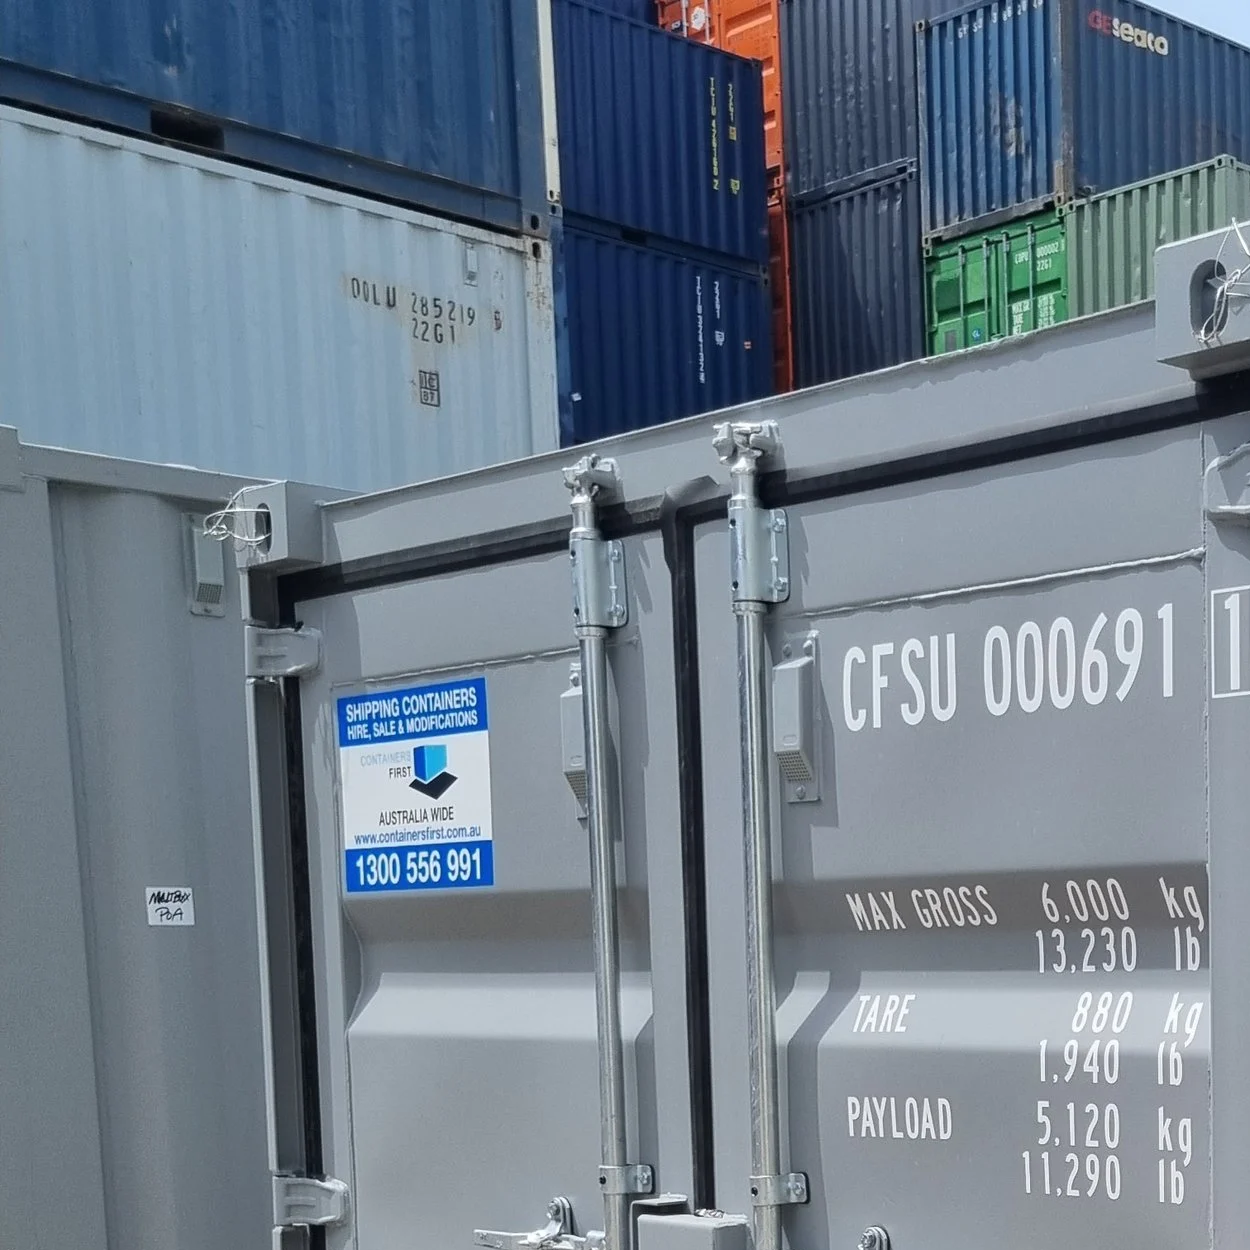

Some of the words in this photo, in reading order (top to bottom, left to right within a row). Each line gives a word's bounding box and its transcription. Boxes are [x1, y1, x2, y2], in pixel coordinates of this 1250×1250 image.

[411, 292, 477, 327] 285219
[411, 318, 456, 345] 22G1
[843, 633, 957, 732] CFSU
[983, 603, 1174, 716] 000691
[346, 697, 400, 723] SHIPPING
[402, 687, 477, 715] CONTAINERS
[347, 722, 372, 742] HIRE,
[373, 720, 397, 738] SALE
[398, 718, 405, 733] &
[406, 710, 478, 733] MODIFICATIONS
[360, 750, 412, 768] CONTAINERS
[389, 766, 412, 778] FIRST
[379, 808, 429, 827] AUSTRALIA
[430, 805, 454, 822] WIDE
[354, 824, 482, 846] www.containersfirst.com.au
[355, 852, 400, 886] 1300
[406, 849, 442, 884] 556
[447, 847, 482, 882] 991
[846, 892, 906, 932] MAX
[910, 885, 998, 929] GROSS
[1041, 877, 1130, 924] 6,000
[1158, 876, 1205, 933] kg
[1035, 926, 1137, 975] 13,230
[1173, 926, 1201, 973] lb
[851, 992, 916, 1034] TARE
[1071, 991, 1134, 1034] 880
[1164, 992, 1204, 1049] kg
[1038, 1039, 1120, 1086] 1,940
[1157, 1040, 1184, 1088] lb
[848, 1095, 954, 1140] PAYLOAD
[1036, 1100, 1121, 1150] 5,120
[1158, 1107, 1193, 1168] kg
[1021, 1150, 1122, 1201] 11,290
[1158, 1159, 1185, 1206] lb
